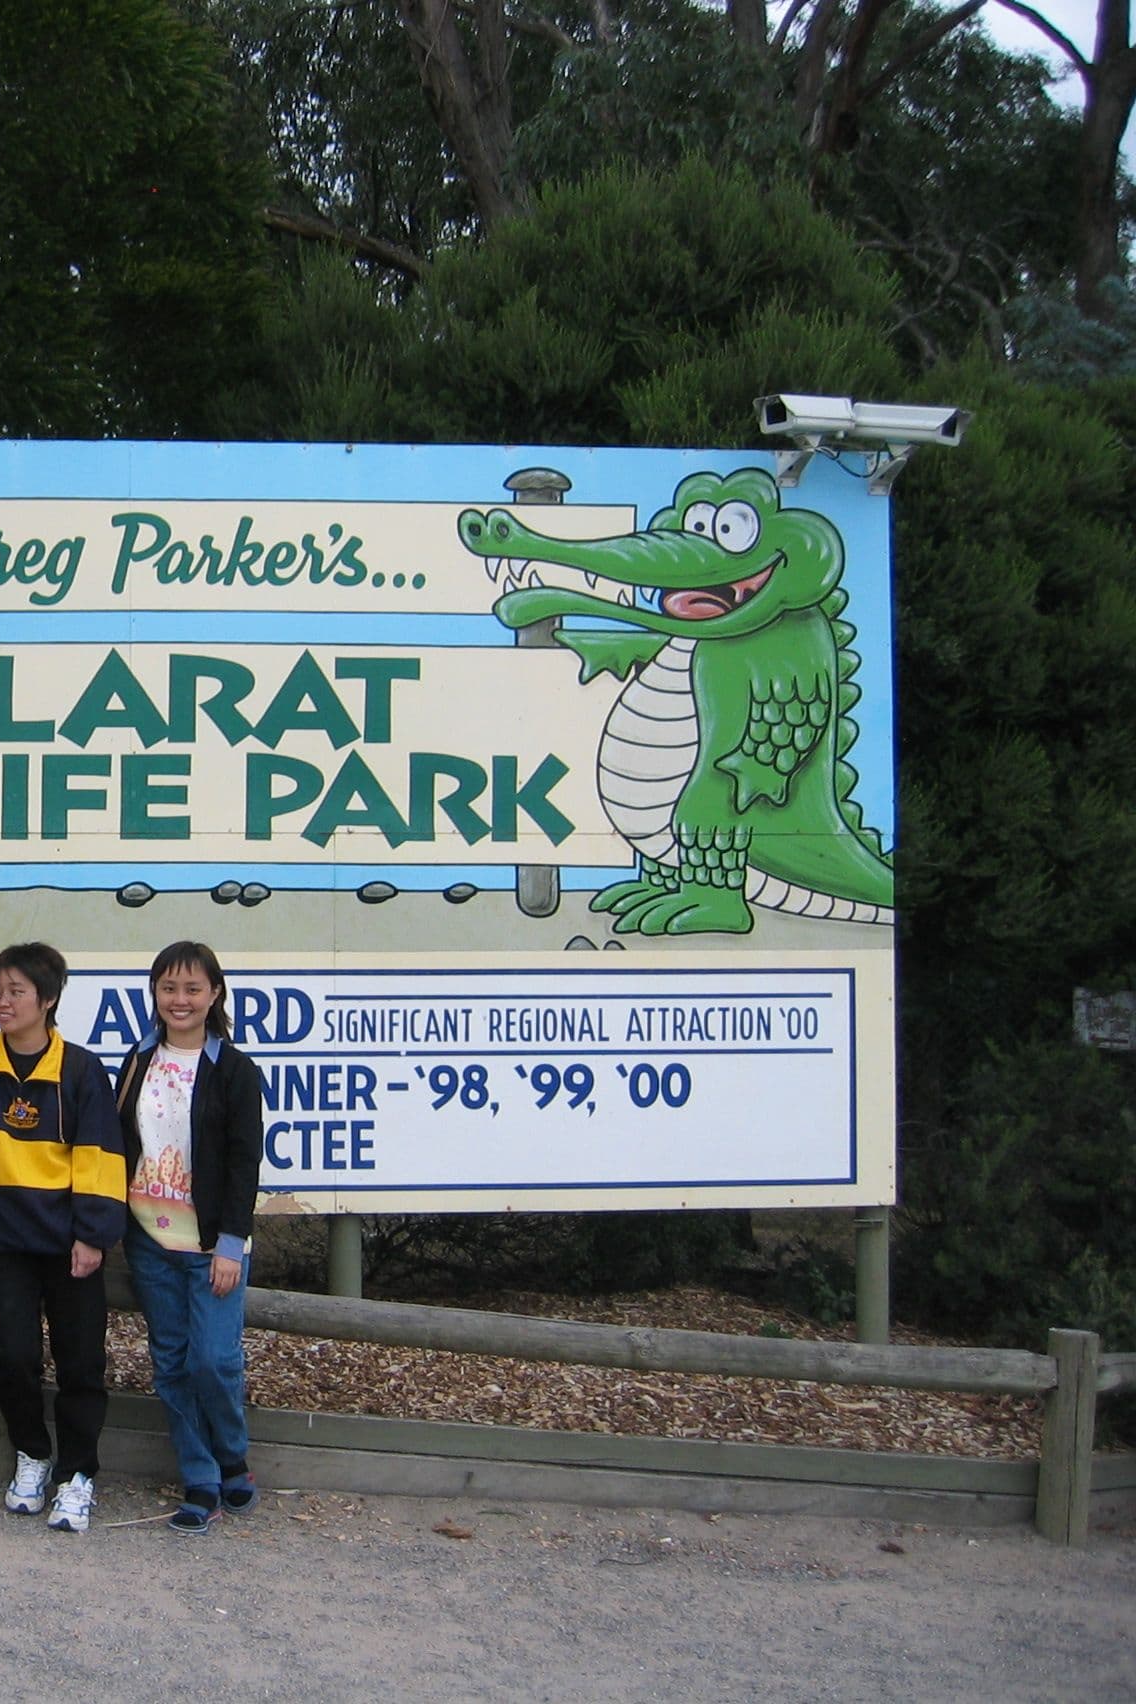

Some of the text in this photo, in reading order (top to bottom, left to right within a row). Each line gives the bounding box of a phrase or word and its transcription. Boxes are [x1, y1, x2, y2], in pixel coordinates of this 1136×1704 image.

[245, 749, 576, 848] PARK
[323, 1008, 473, 1043] SIGNIFICANT
[489, 1007, 610, 1042] REGIONAL
[625, 1006, 771, 1042] ATTRACTION
